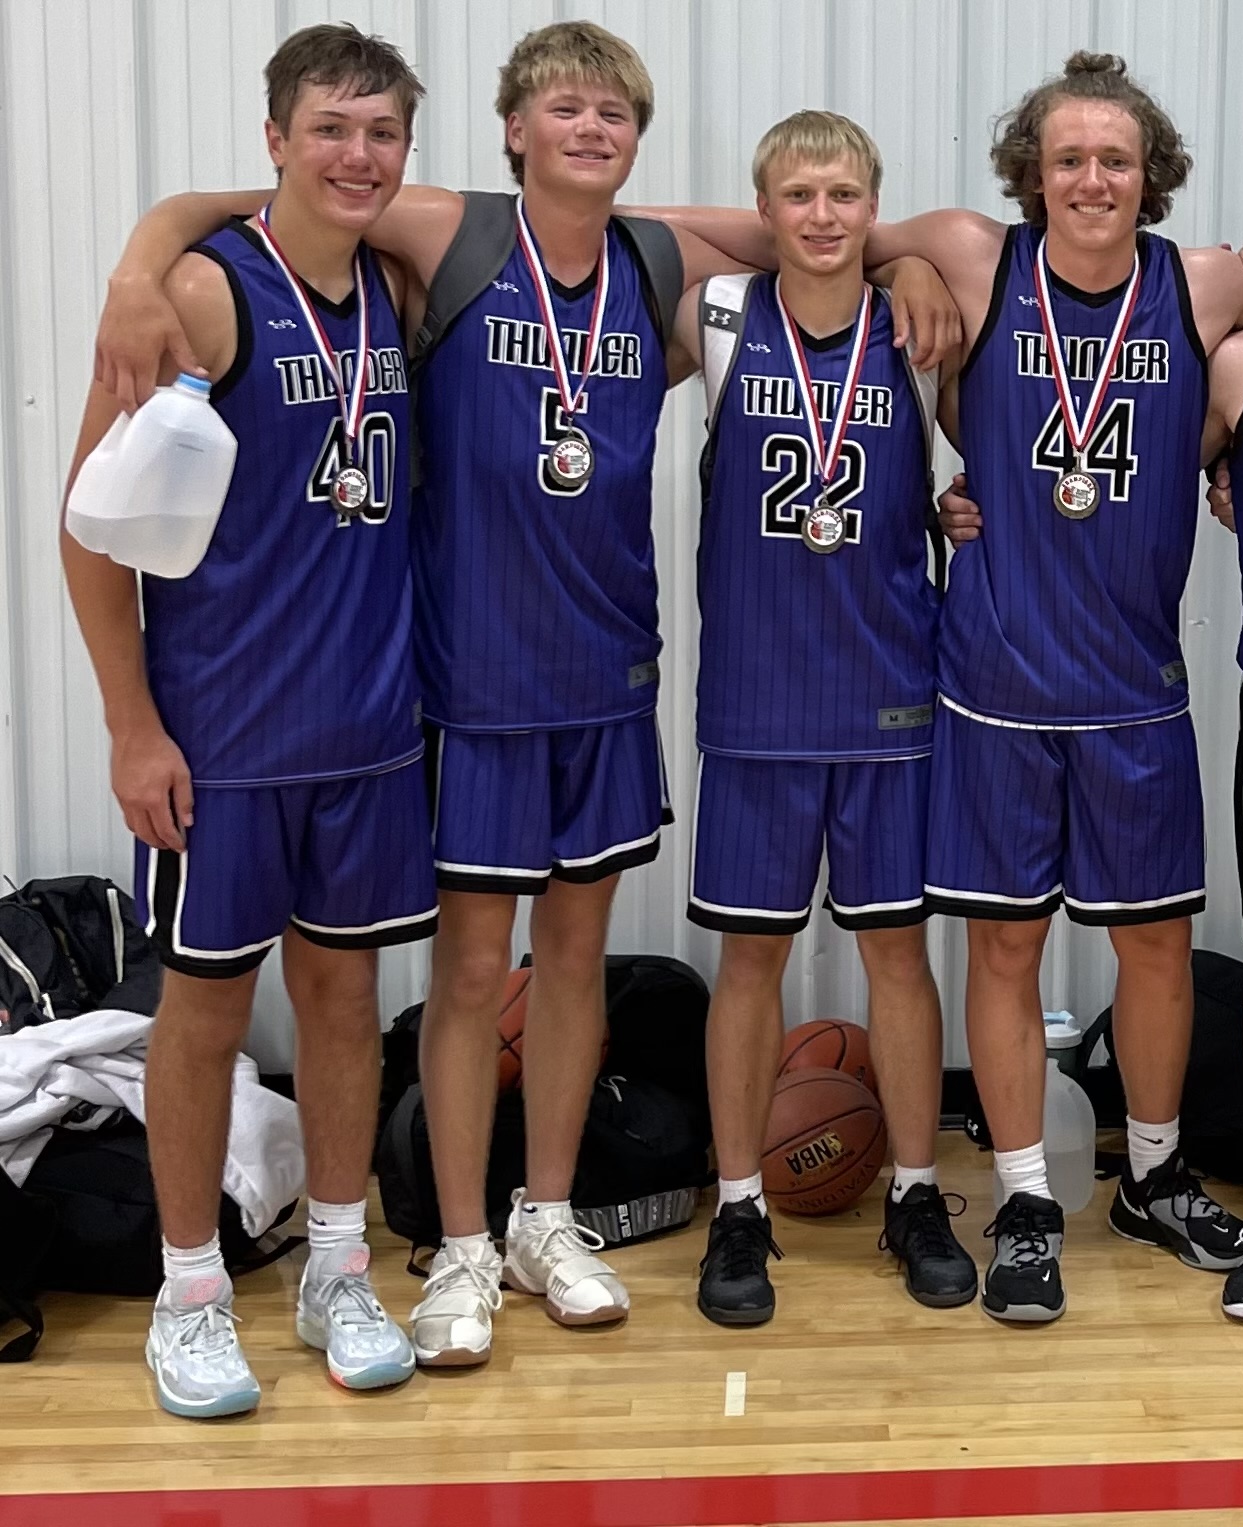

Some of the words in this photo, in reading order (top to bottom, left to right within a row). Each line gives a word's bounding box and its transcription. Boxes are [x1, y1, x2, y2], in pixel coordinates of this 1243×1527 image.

[306, 411, 396, 528] 40
[537, 386, 591, 497] 5
[760, 433, 867, 545] 22
[1031, 397, 1139, 502] 44
[889, 714, 899, 722] M
[785, 1138, 834, 1176] NBA
